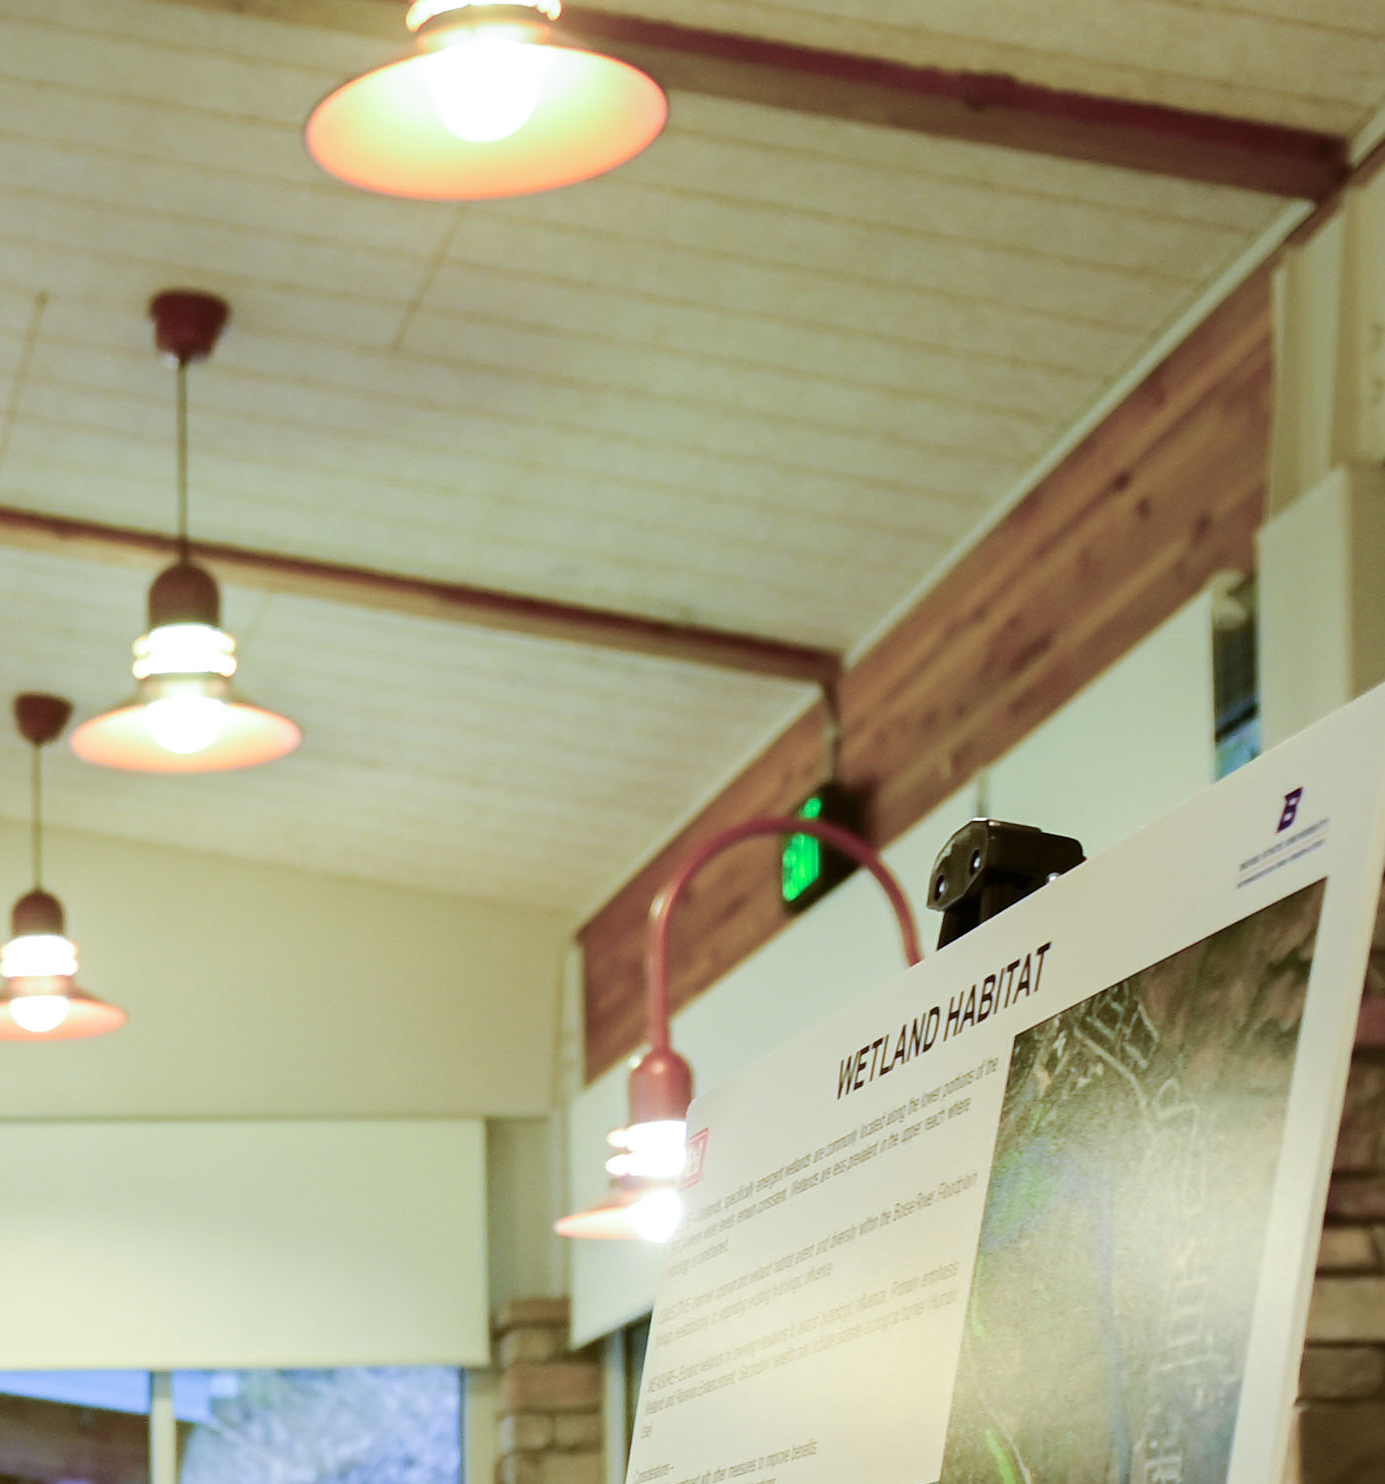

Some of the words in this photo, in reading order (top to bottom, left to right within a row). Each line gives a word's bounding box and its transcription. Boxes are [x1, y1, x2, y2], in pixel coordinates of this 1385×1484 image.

[1276, 786, 1303, 834] B
[836, 1005, 940, 1100] WETLAND
[943, 941, 1051, 1042] HABITAT
